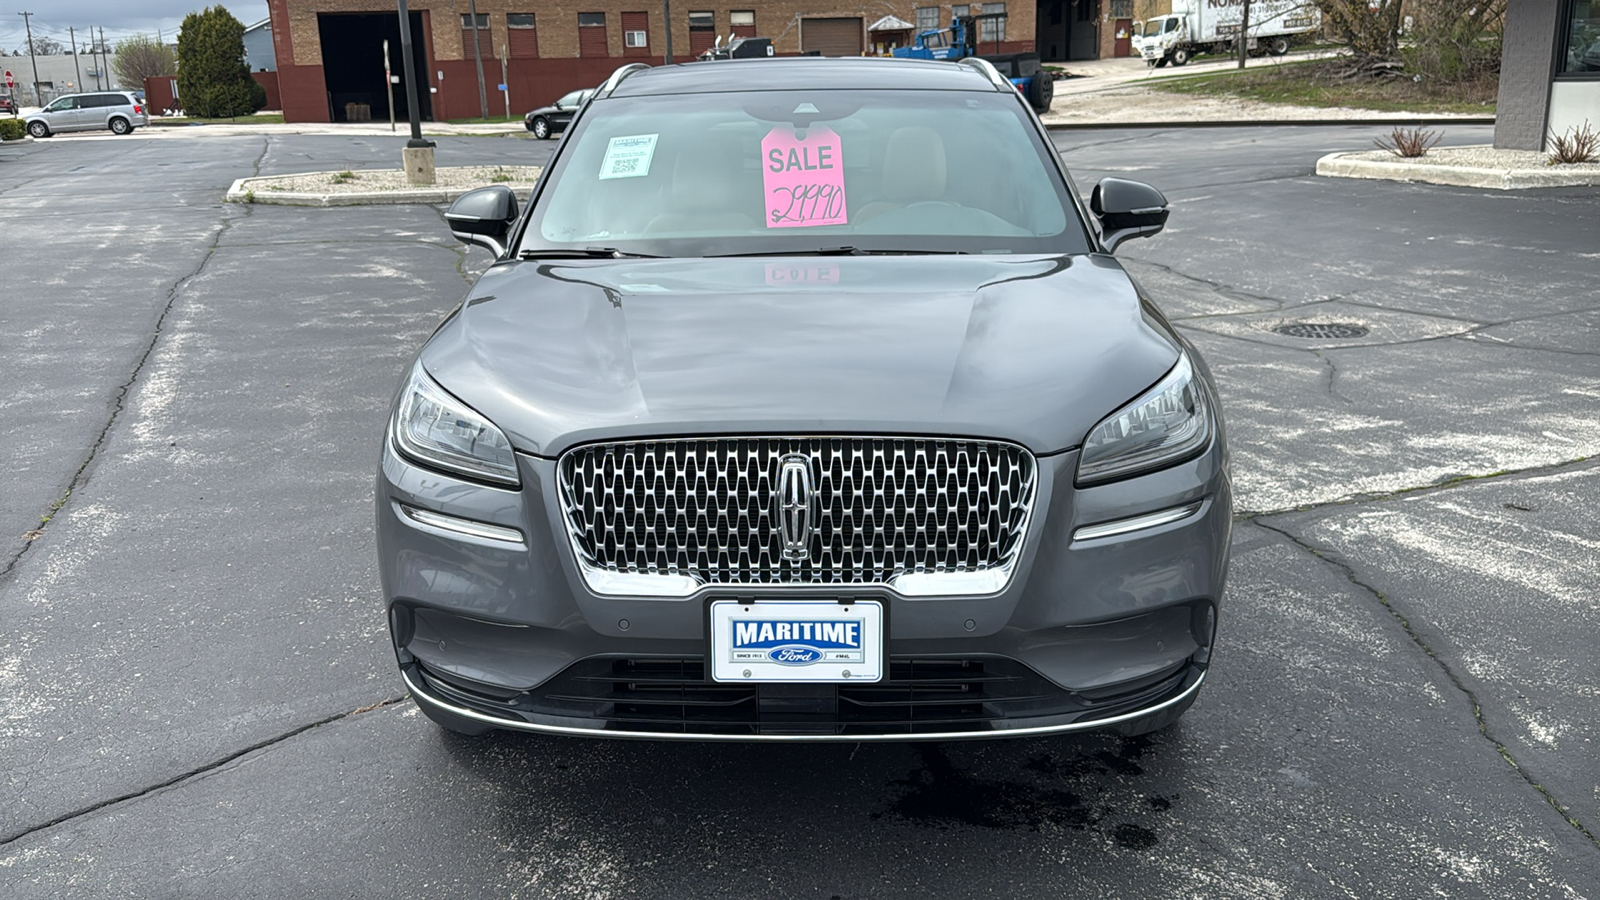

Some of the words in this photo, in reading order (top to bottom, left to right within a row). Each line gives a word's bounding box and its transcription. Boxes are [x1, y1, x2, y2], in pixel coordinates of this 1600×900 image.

[769, 146, 833, 173] SALE
[736, 622, 858, 647] MARITIME
[778, 649, 813, 661] Ford
